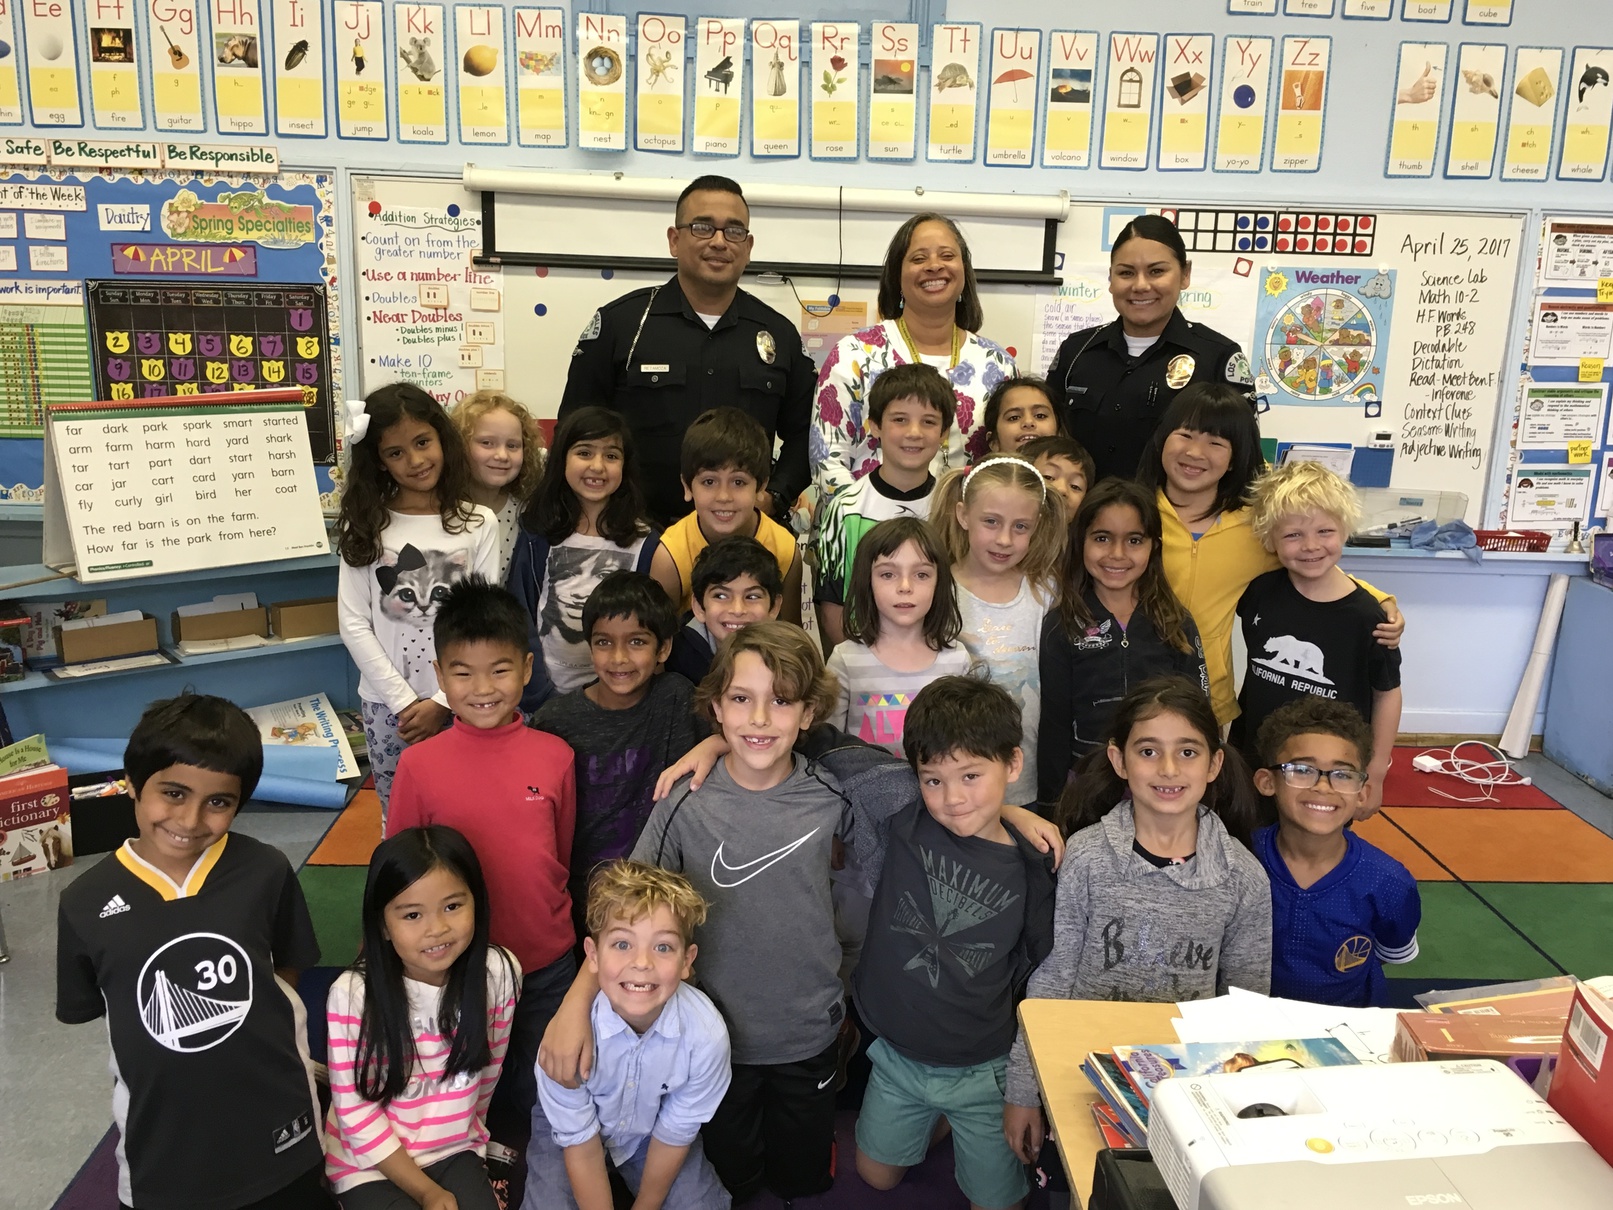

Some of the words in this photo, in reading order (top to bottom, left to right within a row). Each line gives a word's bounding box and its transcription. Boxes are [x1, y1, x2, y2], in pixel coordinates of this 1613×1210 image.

[1418, 6, 1436, 14] boat
[1479, 9, 1497, 18] cube
[642, 18, 681, 43] Oo
[707, 20, 736, 56] Pp
[882, 25, 908, 52] Ss
[1113, 37, 1154, 62] Ww
[1291, 40, 1320, 66] Zz
[49, 112, 65, 122] egg
[112, 114, 126, 122] fire
[167, 117, 191, 126] guitar
[230, 119, 252, 128] hippo
[288, 121, 313, 129] insect
[352, 125, 373, 134] jump
[412, 128, 434, 136] koala
[472, 128, 496, 137] lemon
[535, 132, 551, 142] map
[594, 134, 611, 143] nest
[6, 140, 44, 156] Safe
[644, 136, 676, 146] octopus
[705, 141, 727, 150] piano
[764, 143, 788, 152] queen
[53, 141, 75, 157] Be
[78, 141, 156, 163] Respectful
[168, 144, 188, 159] Be
[190, 145, 275, 167] Responsible
[940, 145, 962, 155] turtle
[993, 152, 1026, 160] umbrella
[1051, 153, 1081, 161] volcano
[1110, 154, 1138, 162] window
[1227, 159, 1250, 168] yo-yo
[1284, 158, 1308, 166] zipper
[1399, 162, 1422, 171] thumb
[1461, 162, 1479, 171] shell
[1512, 166, 1539, 175] cheese
[1571, 166, 1592, 175] whale
[14, 186, 24, 199] of
[29, 188, 47, 200] the
[50, 187, 82, 201] Week
[192, 217, 234, 235] Spring
[238, 217, 311, 234] Specialties
[374, 212, 416, 224] Addition
[424, 213, 475, 230] Strategies
[366, 232, 398, 245] Count
[405, 236, 420, 246] on
[426, 233, 452, 247] from
[456, 235, 479, 247] the
[1400, 232, 1443, 261] April
[1477, 238, 1511, 258] 2017
[375, 246, 414, 261] greater
[419, 247, 464, 259] number
[150, 251, 224, 273] APRIL
[366, 269, 393, 281] Use
[398, 270, 407, 281] a
[411, 268, 460, 281] number
[465, 267, 494, 284] line
[1296, 270, 1361, 284] Weather
[1421, 270, 1464, 286] Science
[1468, 269, 1487, 283] Lab
[25, 284, 33, 293] is
[1058, 282, 1101, 298] winter
[372, 292, 417, 303] Doubles
[1419, 290, 1450, 304] Math
[372, 311, 407, 323] Near
[412, 308, 463, 323] Doubles
[1438, 308, 1466, 322] Words
[400, 326, 434, 334] Doubles
[435, 325, 458, 333] minus
[403, 336, 434, 344] Doubles
[438, 334, 456, 345] plus
[379, 356, 411, 367] Make
[419, 354, 432, 367] 10
[1412, 354, 1463, 371] Dictation
[149, 364, 161, 377] 10
[212, 366, 226, 380] 12
[269, 366, 280, 377] 14
[400, 370, 453, 379] ten-frame
[1404, 402, 1443, 420] Context
[65, 426, 82, 436] far
[103, 424, 128, 434] dark
[143, 422, 168, 433] park
[183, 420, 212, 431] spark
[223, 419, 253, 428] smart
[263, 416, 298, 427] started
[1445, 423, 1476, 444] Writing
[69, 446, 92, 454] arm
[105, 441, 133, 452] farm
[145, 439, 175, 450] harm
[186, 437, 210, 448] hard
[226, 436, 249, 447] yard
[266, 433, 292, 443] shark
[72, 463, 88, 473] tar
[108, 460, 130, 470] tart
[148, 458, 172, 470] part
[189, 455, 211, 466] dart
[229, 453, 253, 463] start
[268, 450, 296, 460] harsh
[1449, 442, 1481, 469] Writing
[75, 482, 93, 491] car
[111, 480, 126, 491] jar
[151, 476, 174, 486] cart
[192, 473, 215, 483] card
[232, 471, 254, 482] yarn
[271, 467, 295, 477] barn
[78, 500, 93, 511] fly
[114, 496, 142, 508] curly
[155, 493, 173, 506] girl
[195, 490, 216, 500] bird
[234, 488, 252, 497] her
[275, 484, 297, 494] coat
[83, 525, 105, 535] The
[113, 522, 131, 533] red
[138, 519, 164, 530] barn
[172, 518, 179, 527] is
[186, 516, 201, 525] on
[207, 513, 224, 523] the
[231, 511, 259, 522] farm.
[87, 543, 113, 554] How
[121, 540, 137, 551] far
[146, 538, 154, 548] is
[161, 536, 180, 546] the
[187, 533, 212, 545] park
[219, 529, 243, 540] from
[249, 526, 276, 538] here?
[1291, 680, 1337, 699] REPUBLIC
[310, 698, 320, 711] The
[316, 710, 333, 738] Writing
[11, 799, 38, 813] first
[0, 806, 60, 827] ictionary
[920, 844, 1020, 912] MAXIMUM
[931, 878, 993, 920] DECIBELS
[100, 903, 131, 918] adidas
[194, 955, 236, 990] 30
[1405, 1193, 1462, 1206] EPSON
